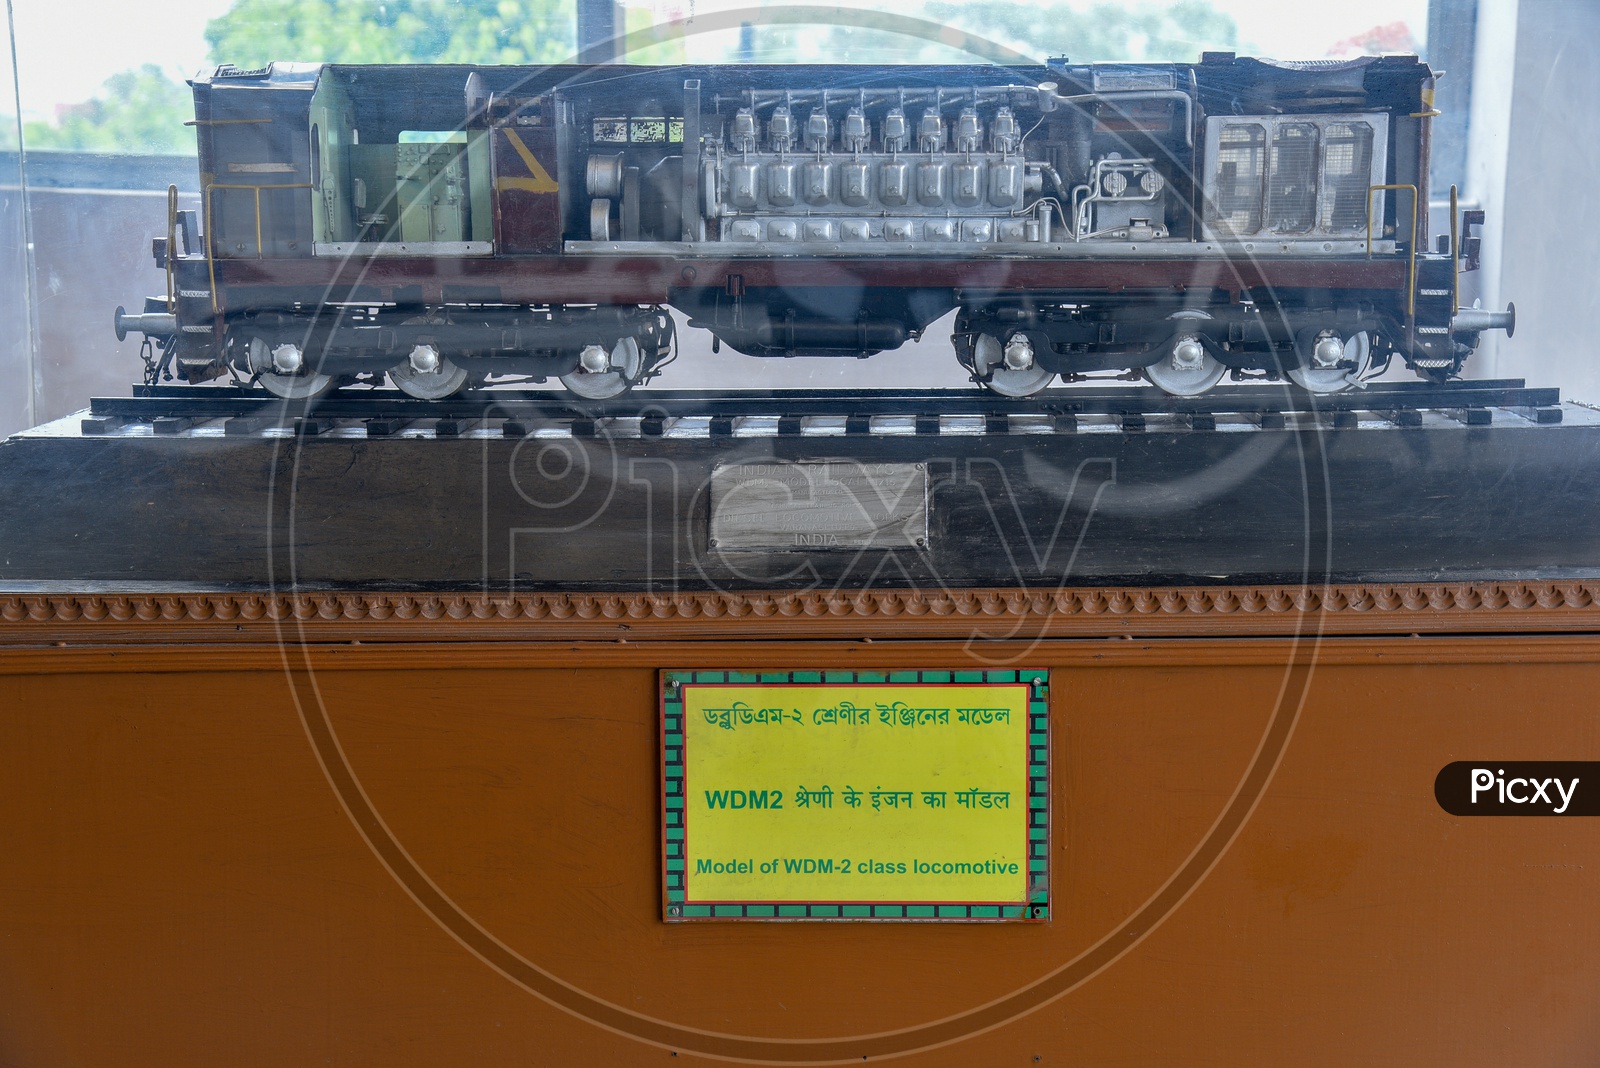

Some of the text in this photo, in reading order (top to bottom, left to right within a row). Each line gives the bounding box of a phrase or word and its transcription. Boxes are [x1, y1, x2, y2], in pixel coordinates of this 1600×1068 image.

[738, 464, 895, 476] INDIAN RAILWAYS
[775, 512, 853, 522] LOCOMOTIVE
[794, 533, 839, 546] INDIA
[813, 702, 871, 725] শ্রেণীর
[875, 702, 950, 728] ইঞ্জিনের
[956, 709, 1010, 725] মডেল
[705, 785, 1010, 811] WDM2 श्रेणी के इंजन का मॉडल
[697, 859, 1018, 874] Model of WDM-2 class locomotive
